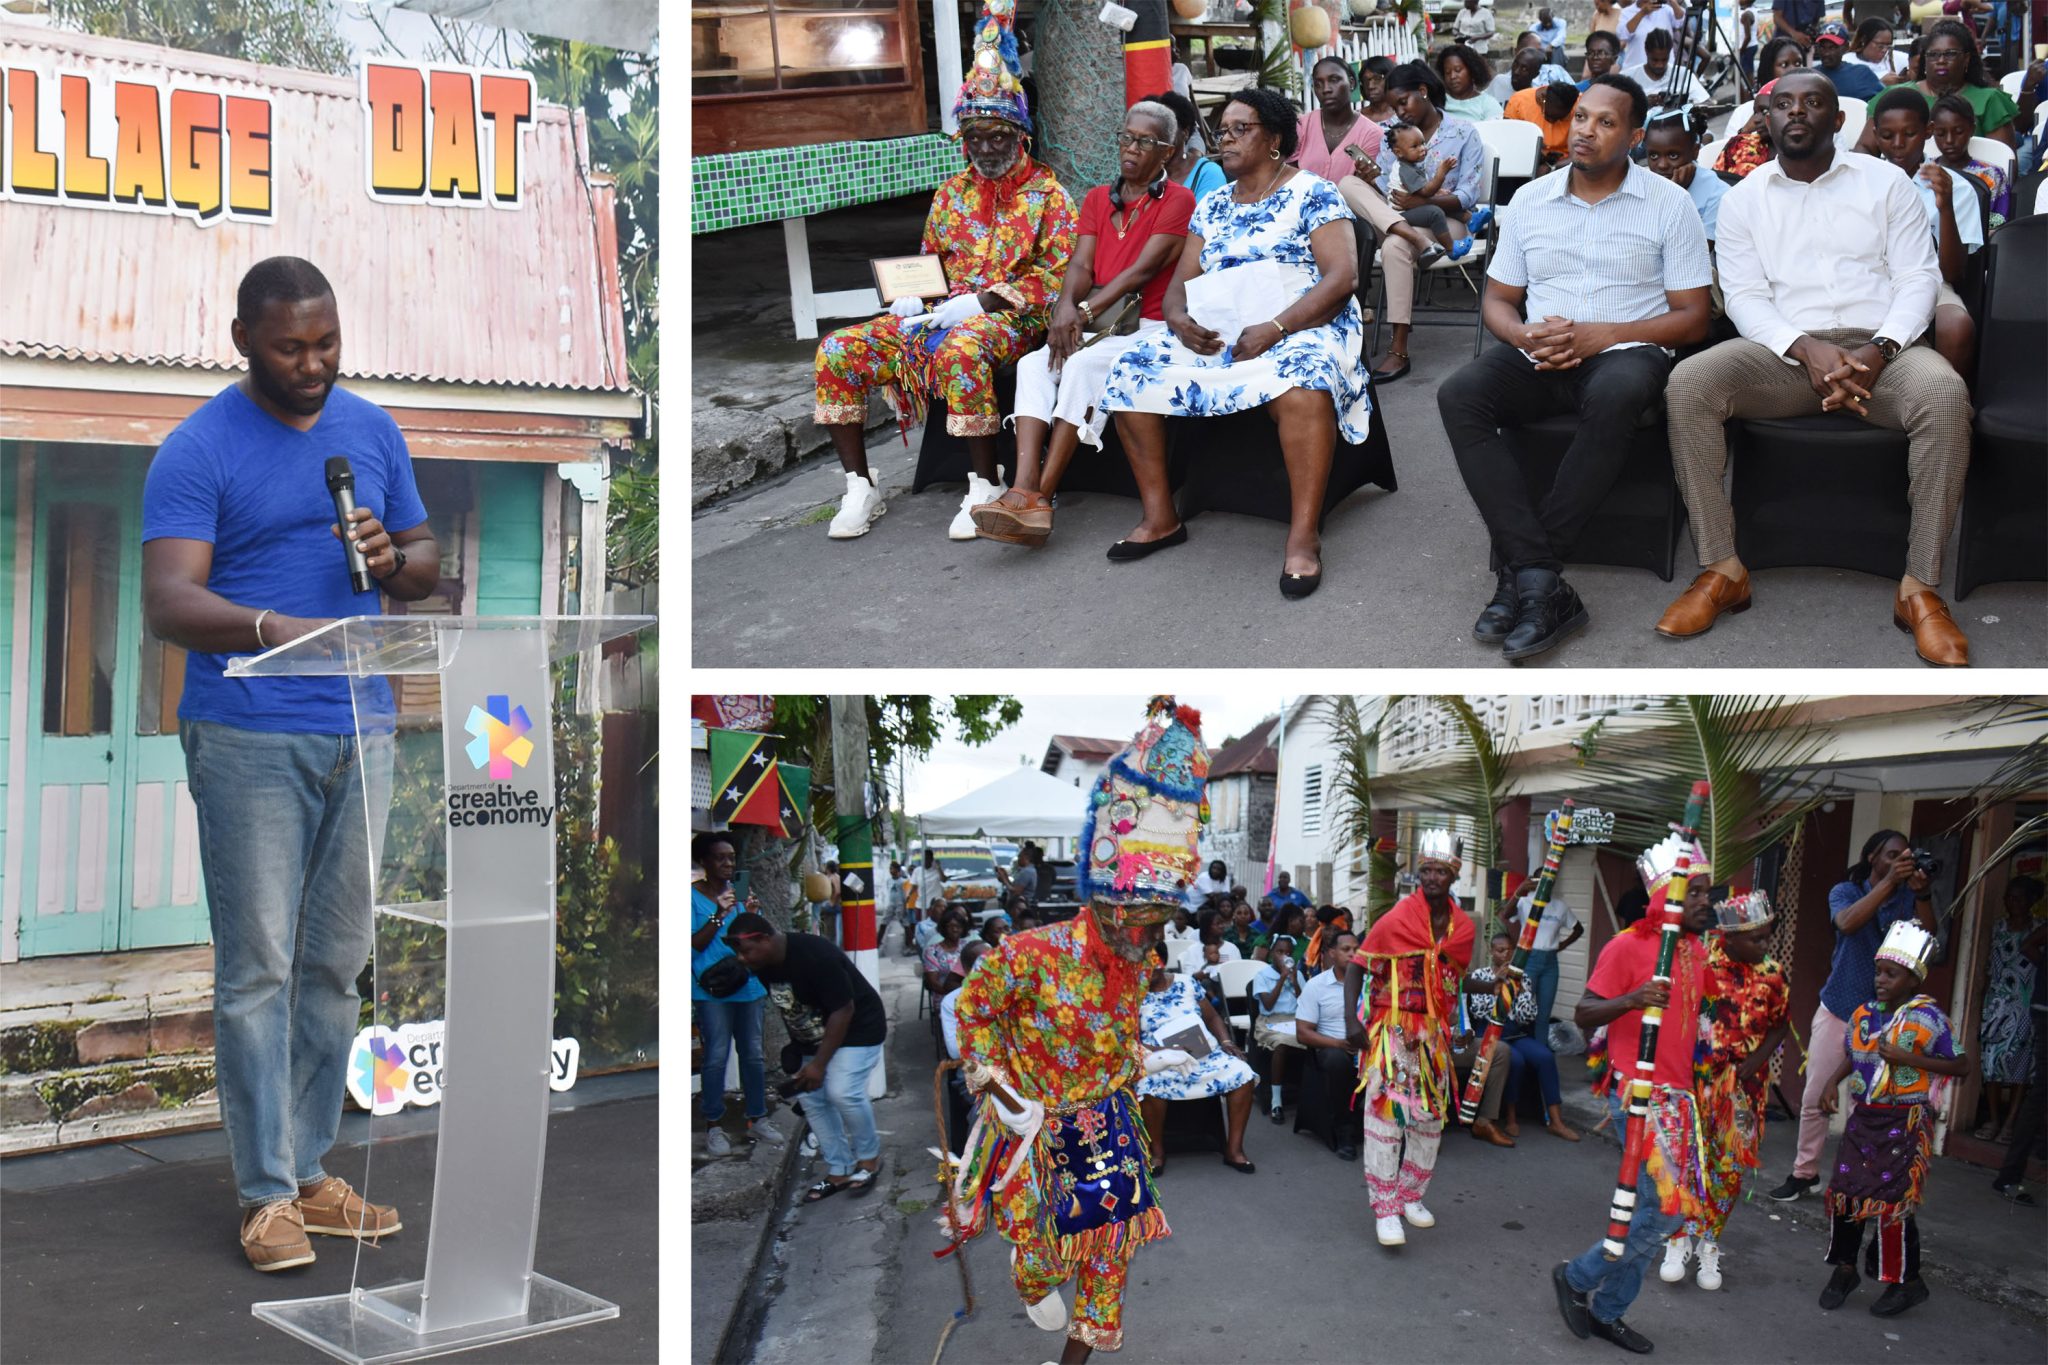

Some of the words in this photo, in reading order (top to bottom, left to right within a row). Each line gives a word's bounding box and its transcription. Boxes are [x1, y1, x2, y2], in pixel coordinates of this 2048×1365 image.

[0, 66, 272, 220] LLAGE
[368, 63, 531, 202] DAT
[449, 784, 539, 809] creative
[449, 806, 554, 827] economy
[407, 1030, 445, 1044] Depart
